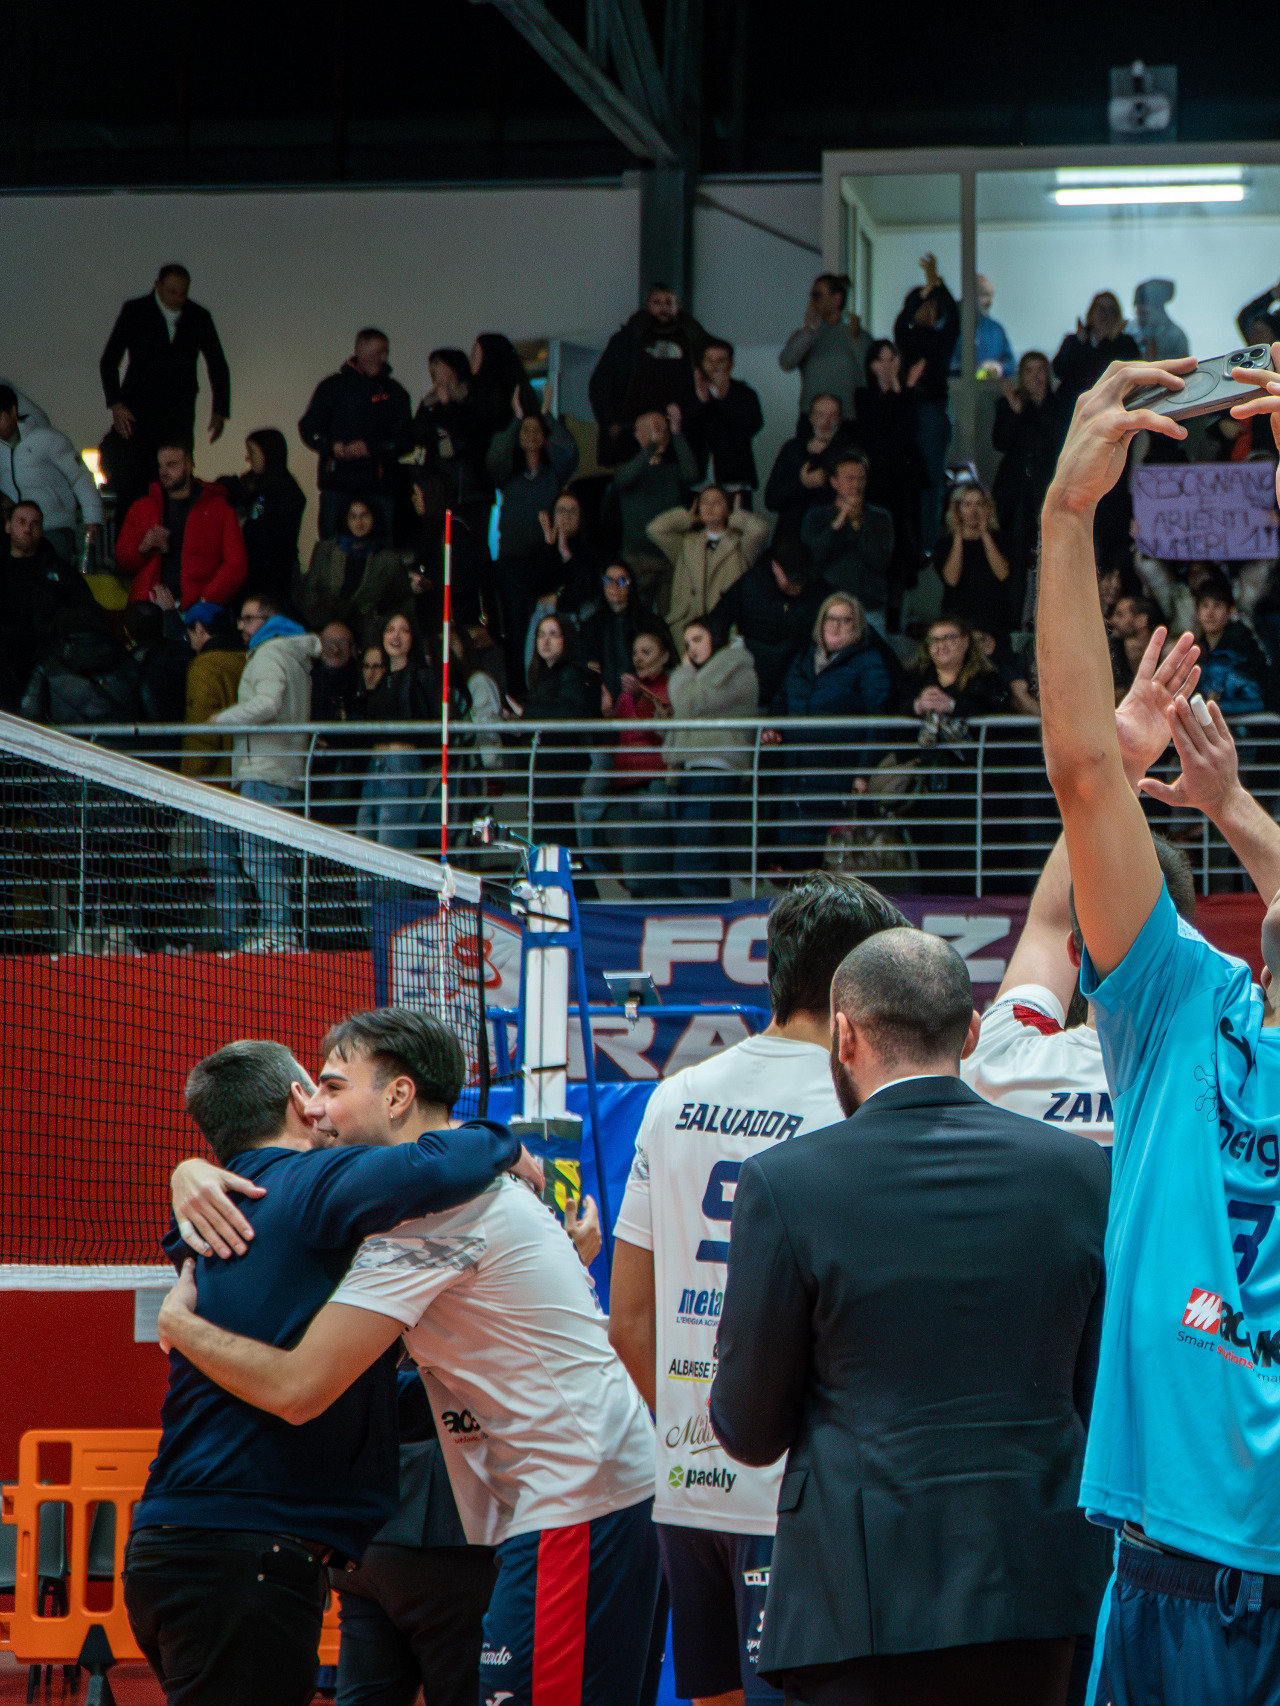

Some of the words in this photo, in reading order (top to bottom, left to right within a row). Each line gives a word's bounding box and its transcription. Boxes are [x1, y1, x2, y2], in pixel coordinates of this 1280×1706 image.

[675, 1102, 805, 1141] SALVADOR
[1043, 1092, 1114, 1123] ZAN
[678, 1288, 724, 1317] meta
[1176, 1329, 1215, 1352] Smart
[685, 1467, 737, 1493] packly
